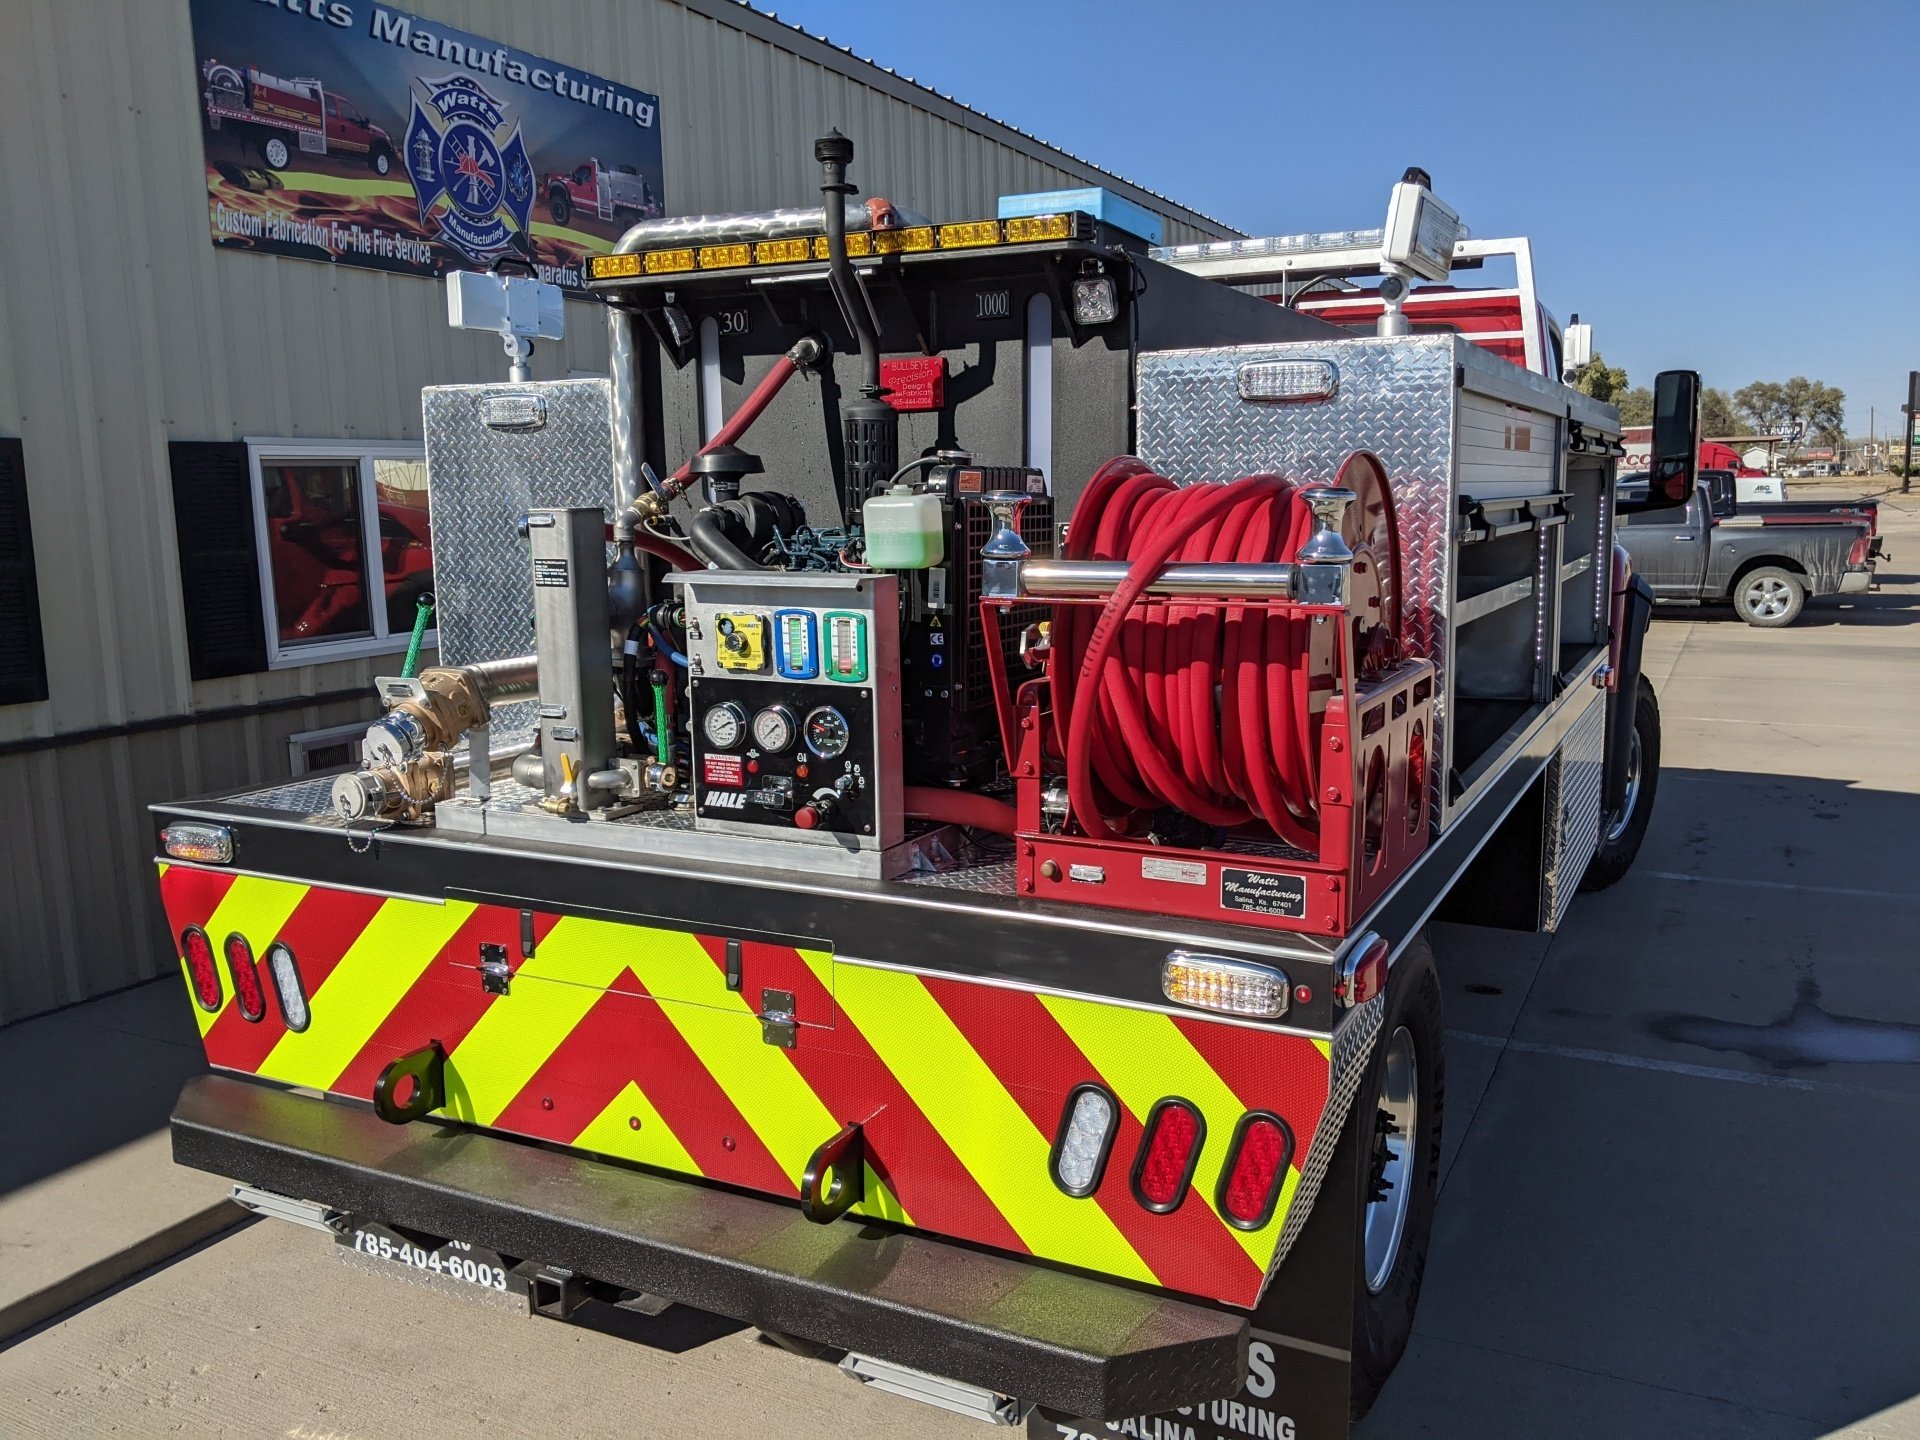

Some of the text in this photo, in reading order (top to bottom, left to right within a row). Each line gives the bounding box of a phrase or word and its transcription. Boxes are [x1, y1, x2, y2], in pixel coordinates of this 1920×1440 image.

[371, 8, 655, 128] Manufacturing
[438, 91, 499, 126] Watts
[217, 109, 323, 135] Watts Manufacturing
[216, 202, 431, 264] Custom Fabrication For The Fire Service
[448, 214, 504, 245] Manufacturing
[527, 257, 578, 287] paratus
[979, 292, 1006, 316] 1000
[722, 311, 744, 333] 30
[891, 360, 929, 371] BULLSEYE
[888, 369, 933, 388] Precision
[902, 383, 926, 391] Design
[704, 791, 747, 809] HALE
[1246, 873, 1279, 886] Watts
[1224, 881, 1302, 902] Manufacturing
[1241, 903, 1285, 915] 785-404-6003
[1272, 900, 1292, 909] 67401
[354, 1230, 507, 1291] 785-404-6003
